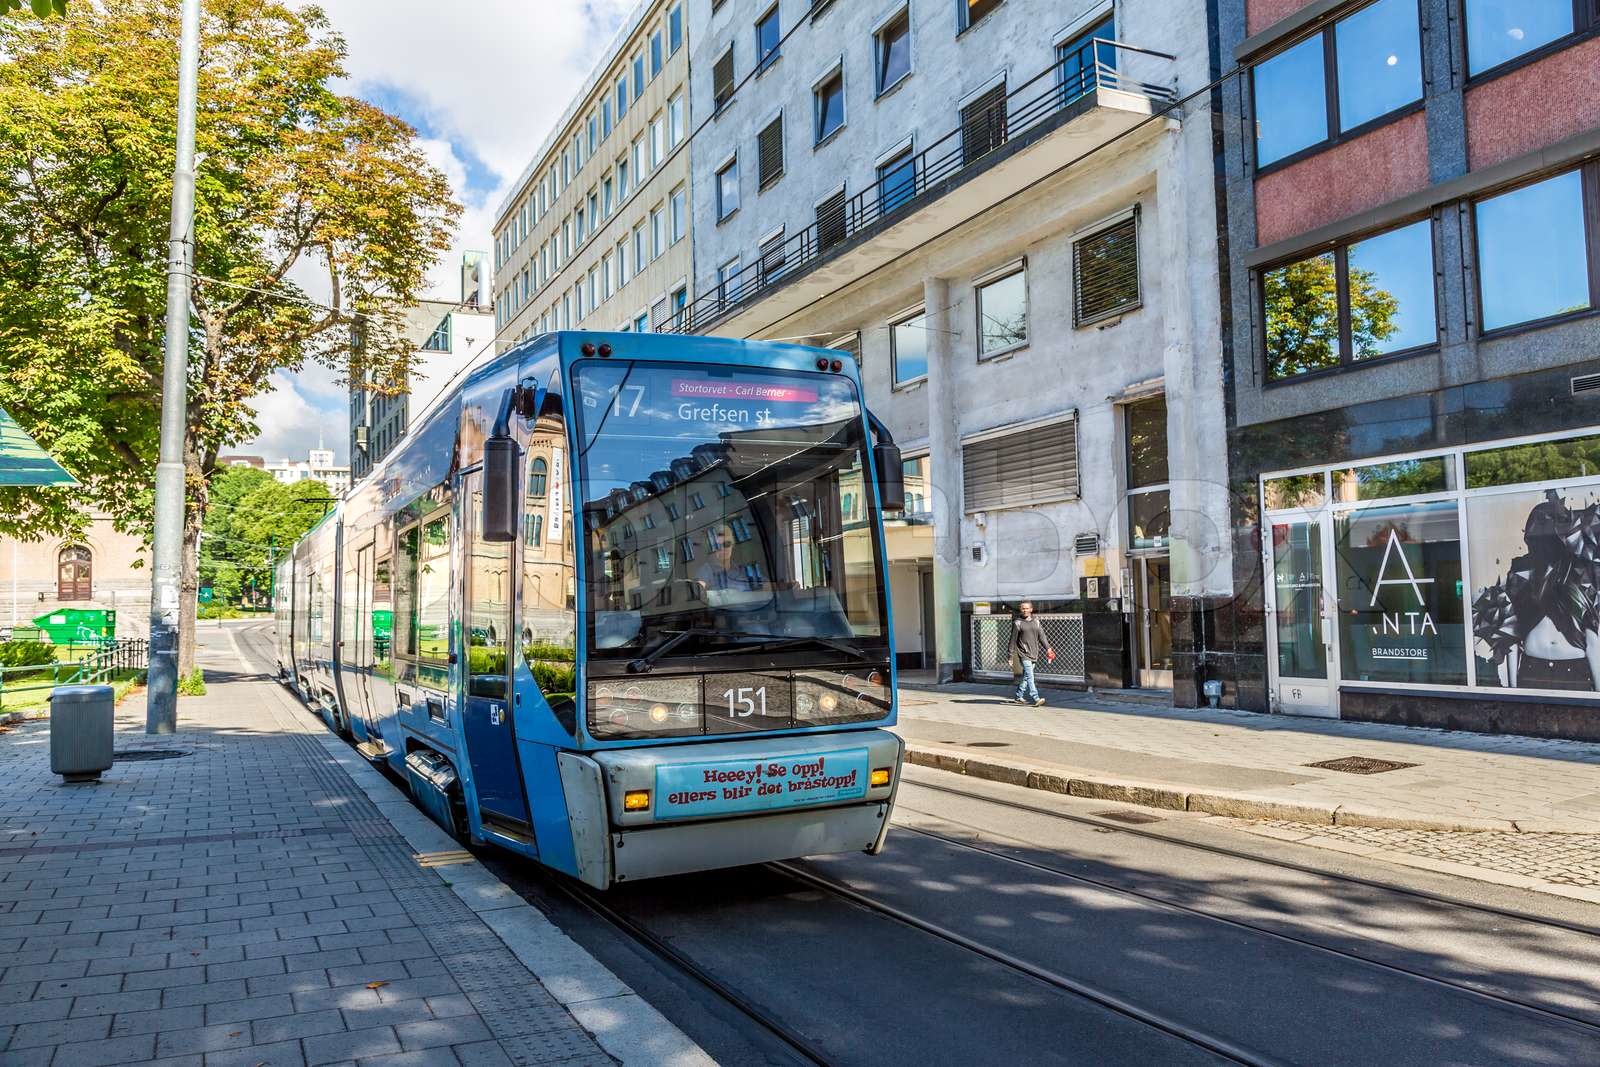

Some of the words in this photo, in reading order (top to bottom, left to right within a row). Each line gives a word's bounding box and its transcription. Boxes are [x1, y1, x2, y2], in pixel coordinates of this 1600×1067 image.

[608, 384, 645, 417] 17
[680, 383, 726, 394] Stortorvet
[735, 386, 754, 396] Carl
[755, 387, 786, 397] Berner
[678, 403, 749, 422] Grefsen
[1372, 648, 1428, 657] BRANDSTORE
[723, 686, 766, 718] 151
[704, 764, 761, 784] Heeey!
[767, 763, 786, 777] Se
[668, 790, 717, 804] ellers
[723, 785, 752, 800] blir
[757, 782, 782, 796] det
